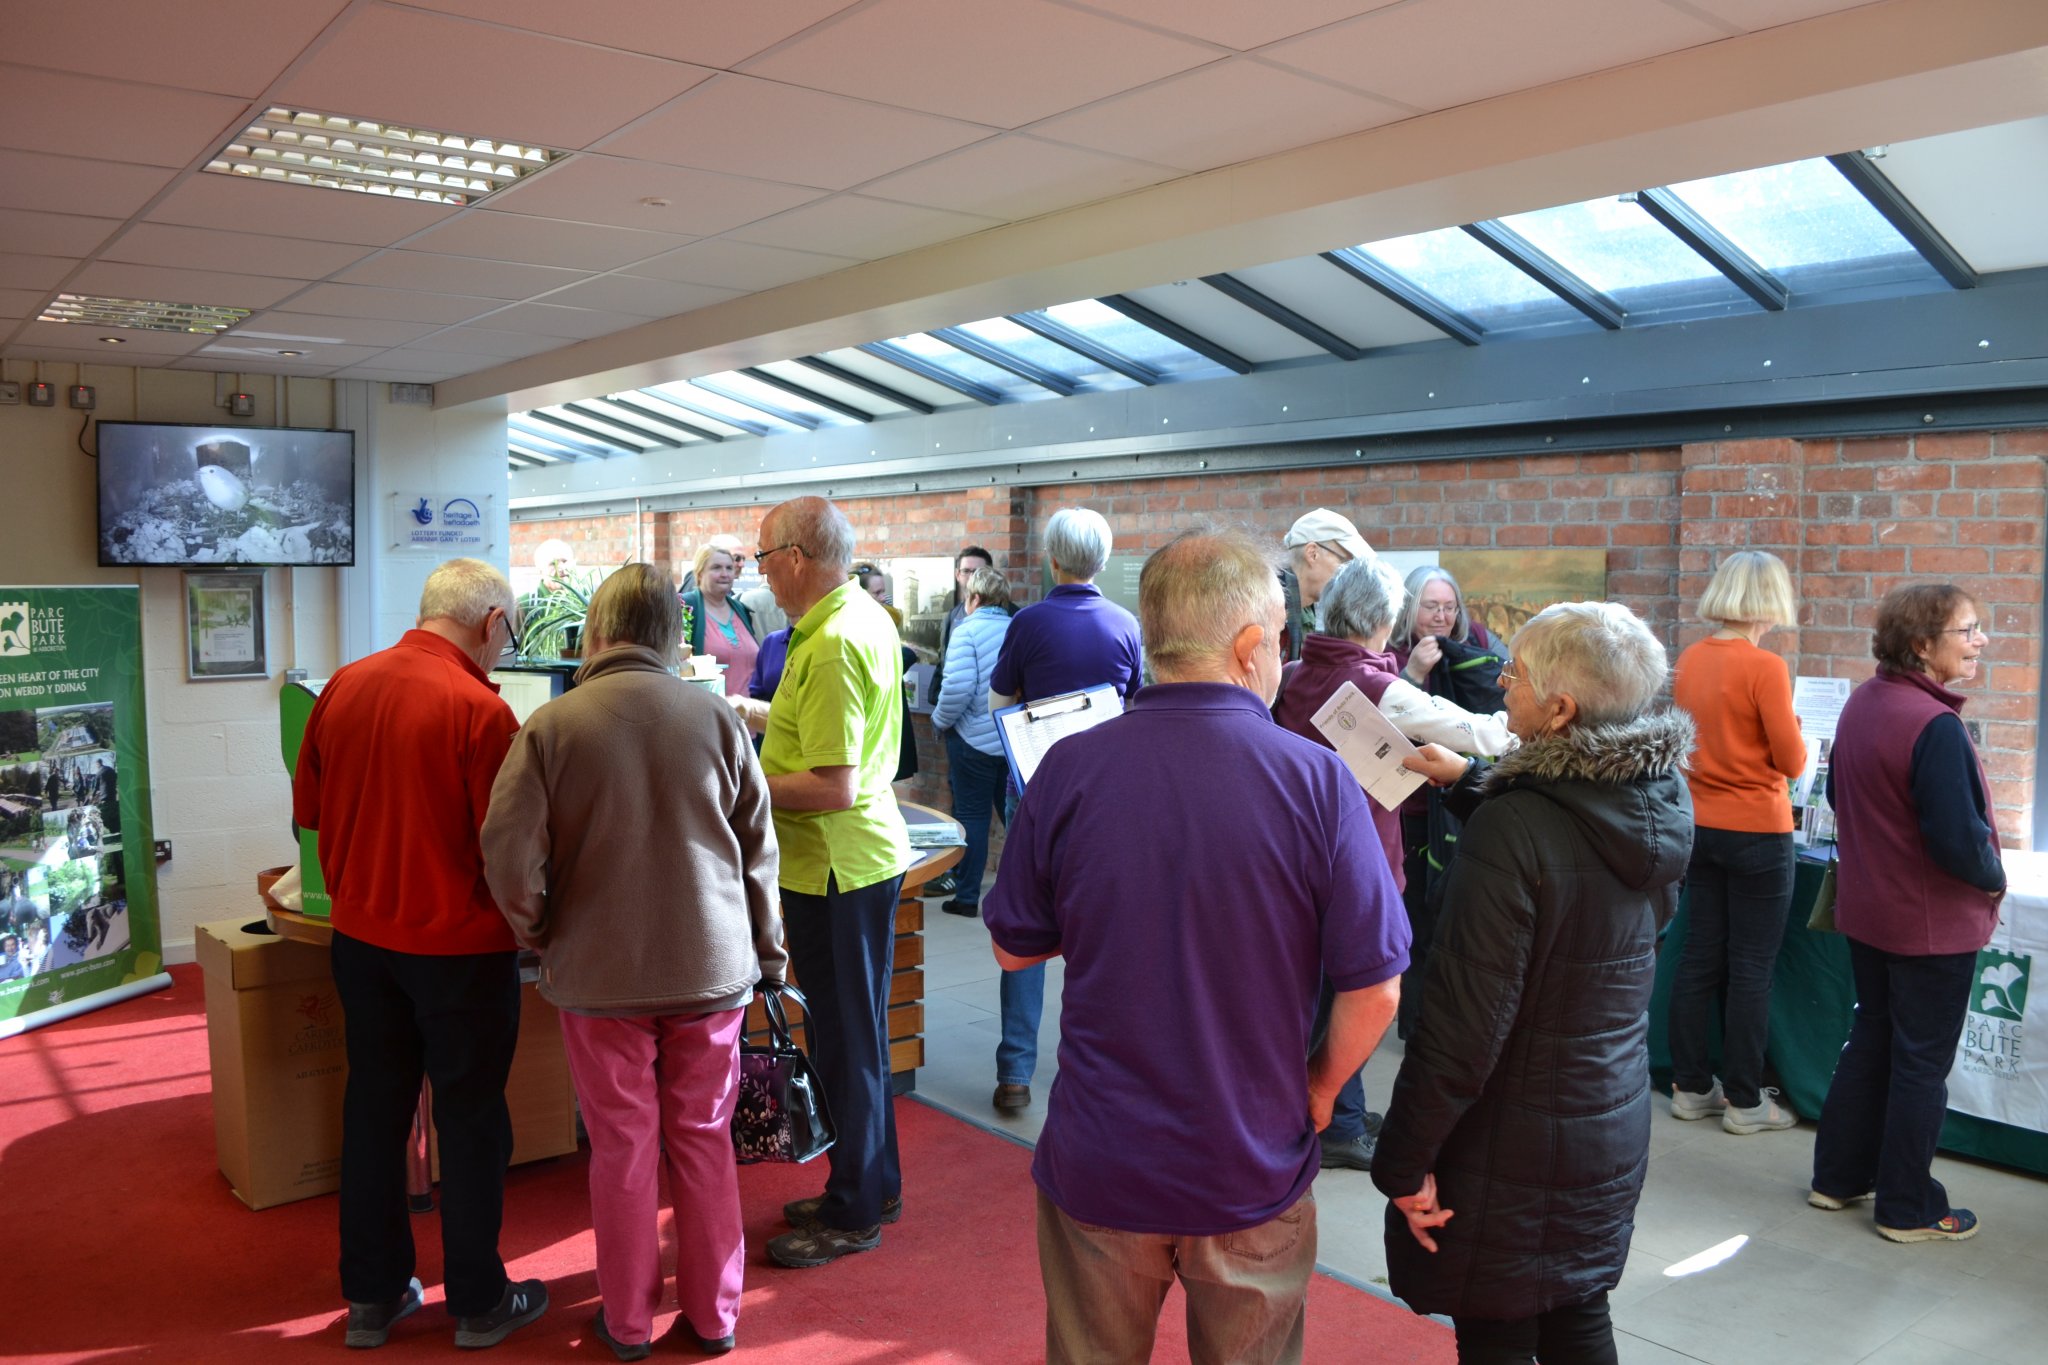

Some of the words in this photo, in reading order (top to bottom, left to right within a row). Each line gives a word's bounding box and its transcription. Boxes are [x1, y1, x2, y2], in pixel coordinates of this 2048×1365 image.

[30, 607, 65, 618] PARC
[31, 618, 65, 634] BUTE
[32, 634, 66, 646] PARK
[18, 672, 47, 682] HEART
[48, 671, 60, 680] OF
[63, 670, 79, 679] THE
[81, 668, 99, 677] CITY
[13, 685, 46, 697] WERDD
[46, 684, 53, 694] Y
[55, 682, 87, 693] DDINAS
[1967, 1015, 2023, 1038] PARC
[1966, 1030, 2022, 1058] BUTE
[1964, 1050, 2021, 1073] PARK
